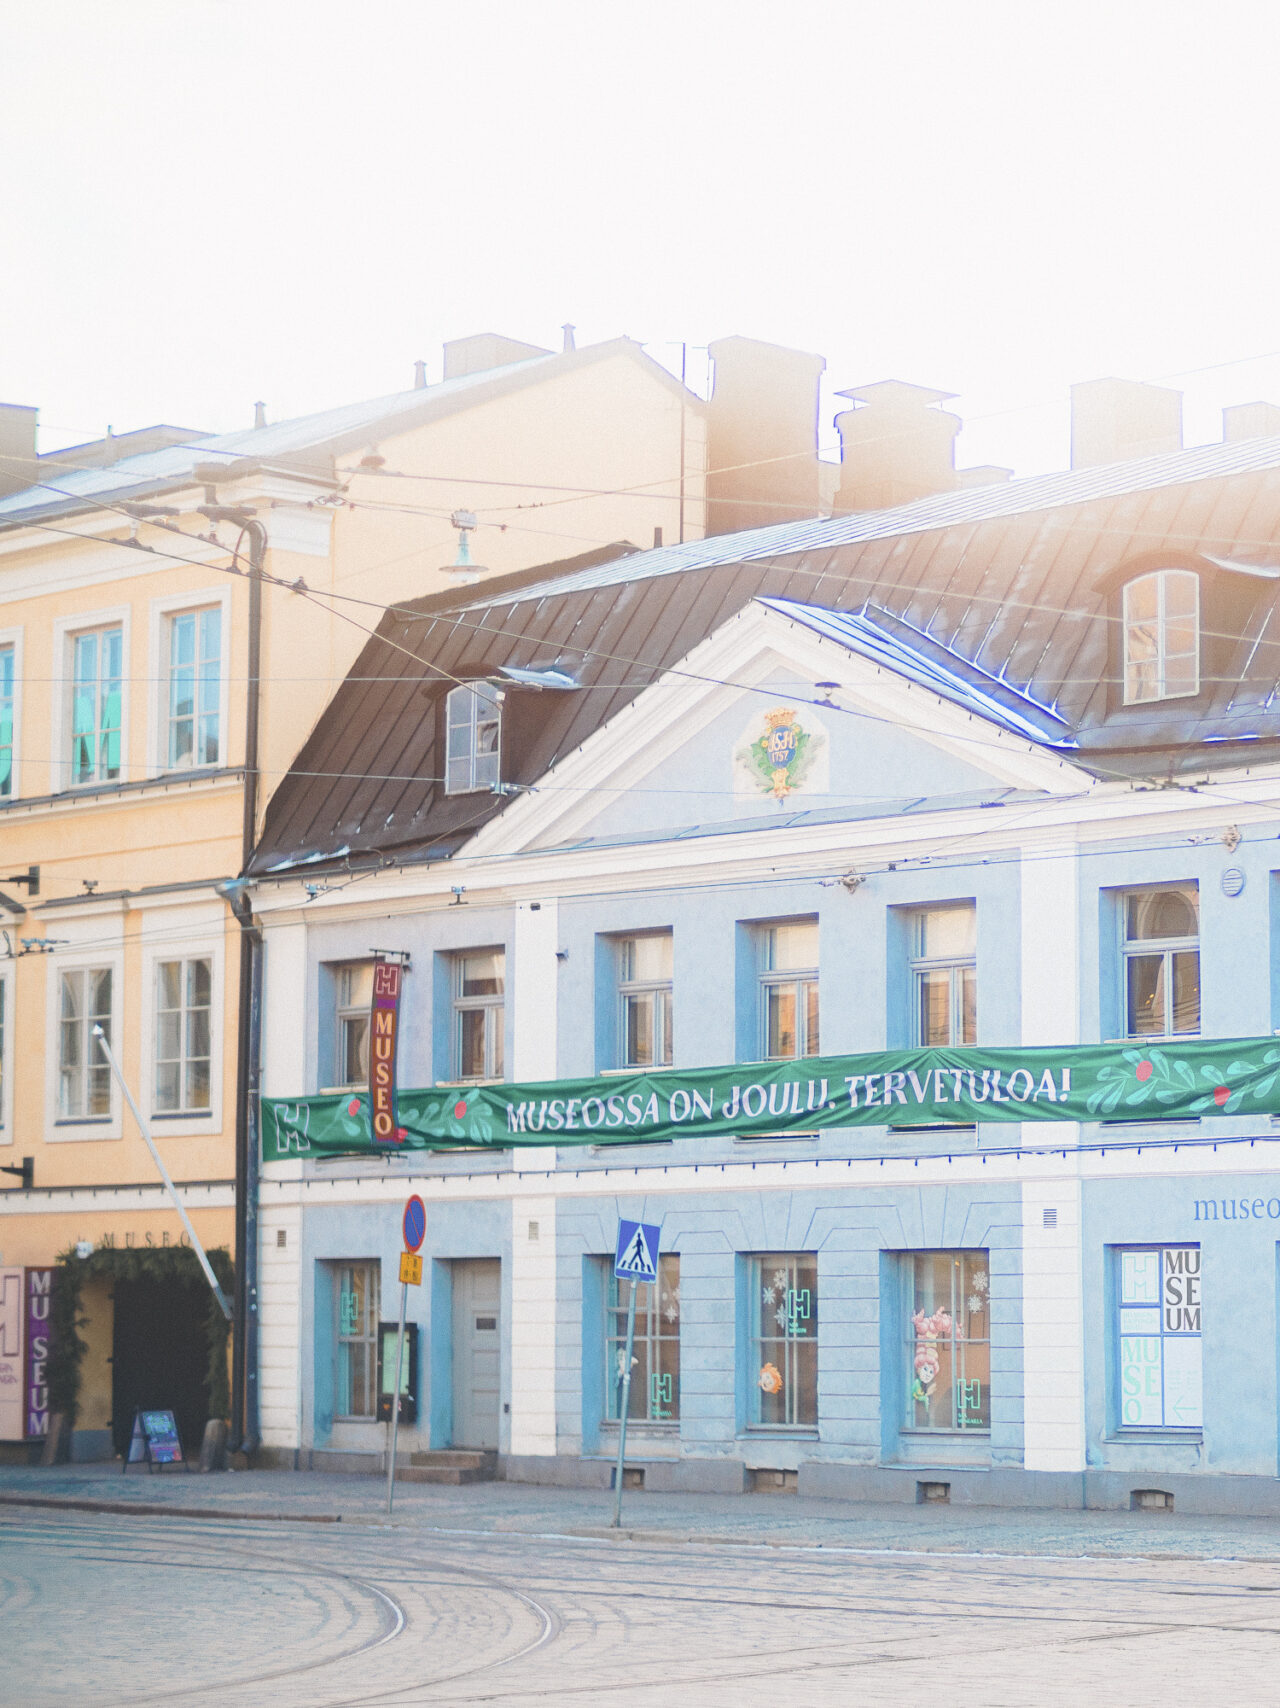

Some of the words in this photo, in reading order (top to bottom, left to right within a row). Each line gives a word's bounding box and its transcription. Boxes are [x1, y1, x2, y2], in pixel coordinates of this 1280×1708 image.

[374, 1010, 394, 1136] MUSEO
[506, 1092, 660, 1134] MUSEOSSA
[668, 1087, 714, 1122] ON
[721, 1077, 837, 1120] JOULU.
[844, 1067, 1072, 1109] TERVETULOA!
[1165, 1250, 1201, 1274] MU
[1165, 1276, 1201, 1306] SE
[1165, 1307, 1201, 1331] UM
[30, 1271, 50, 1435] MUSEUM
[1122, 1338, 1160, 1363] MU
[1122, 1364, 1161, 1397] SE
